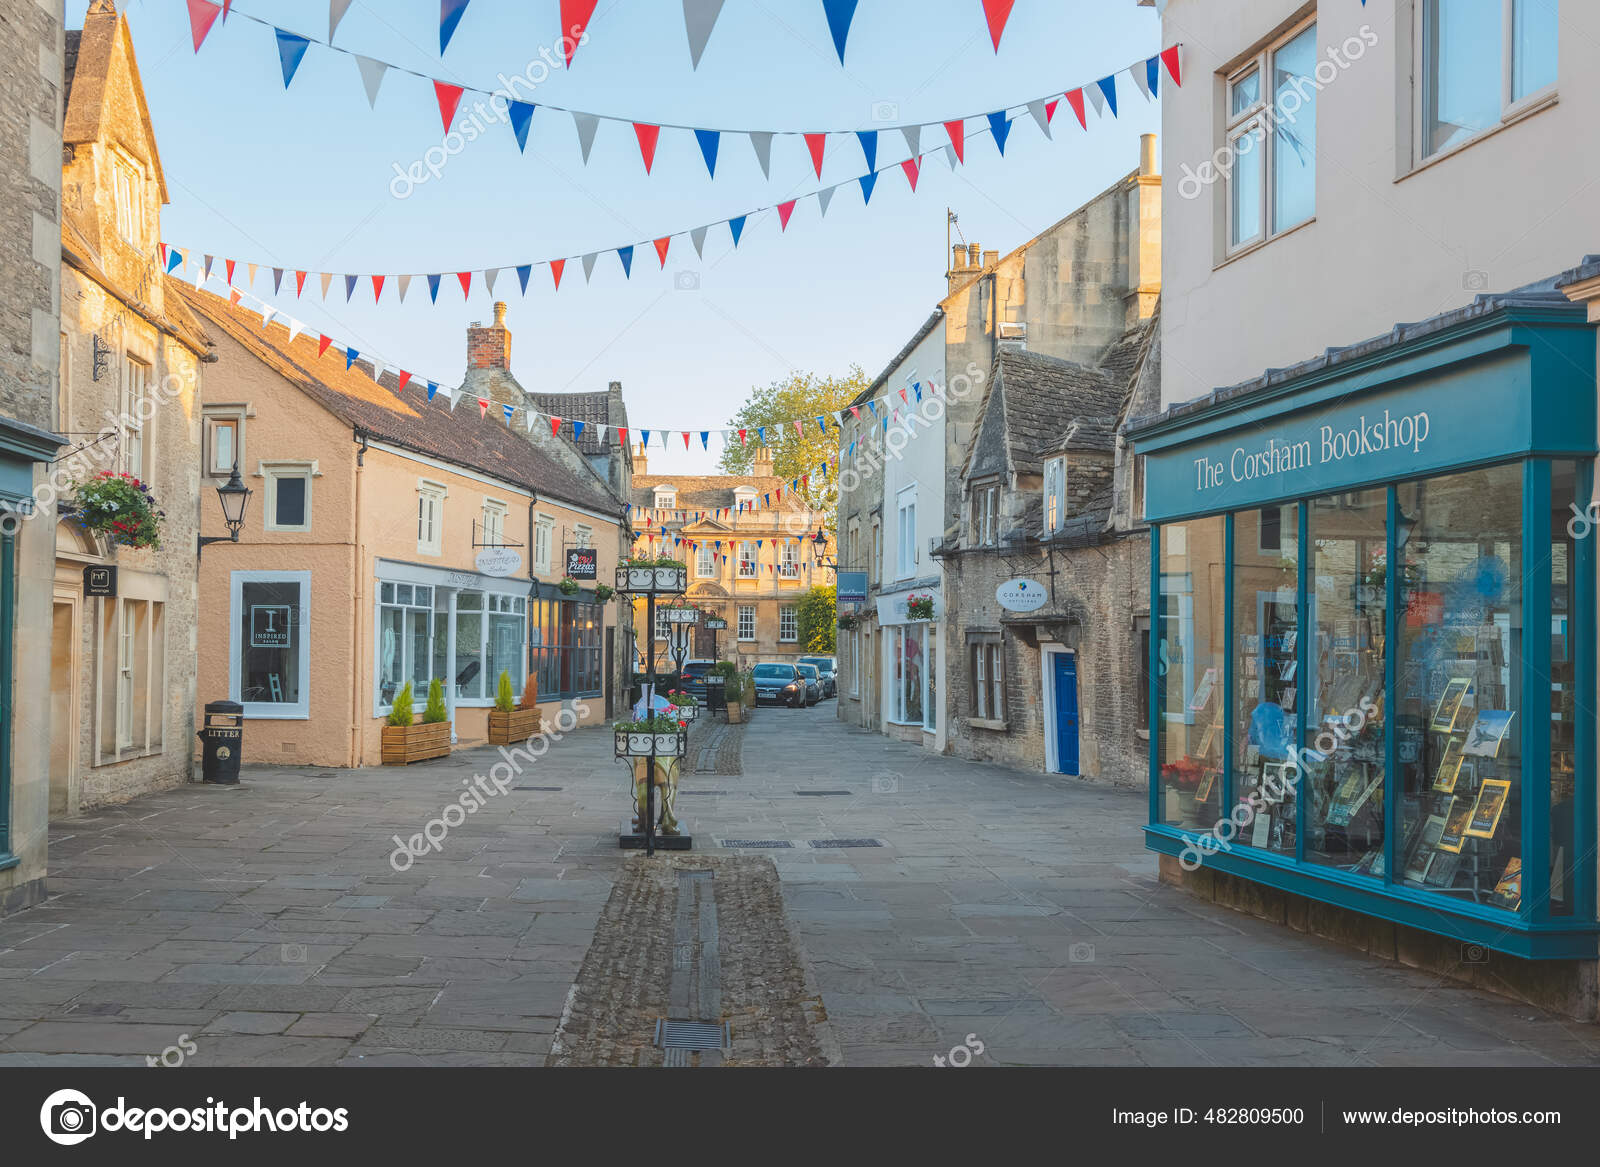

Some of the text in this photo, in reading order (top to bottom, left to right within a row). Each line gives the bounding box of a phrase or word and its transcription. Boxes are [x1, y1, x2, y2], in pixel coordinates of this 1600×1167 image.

[1193, 409, 1430, 491] The Corsham Bookshop
[568, 561, 596, 570] Pizzas
[208, 730, 240, 738] LITTER
